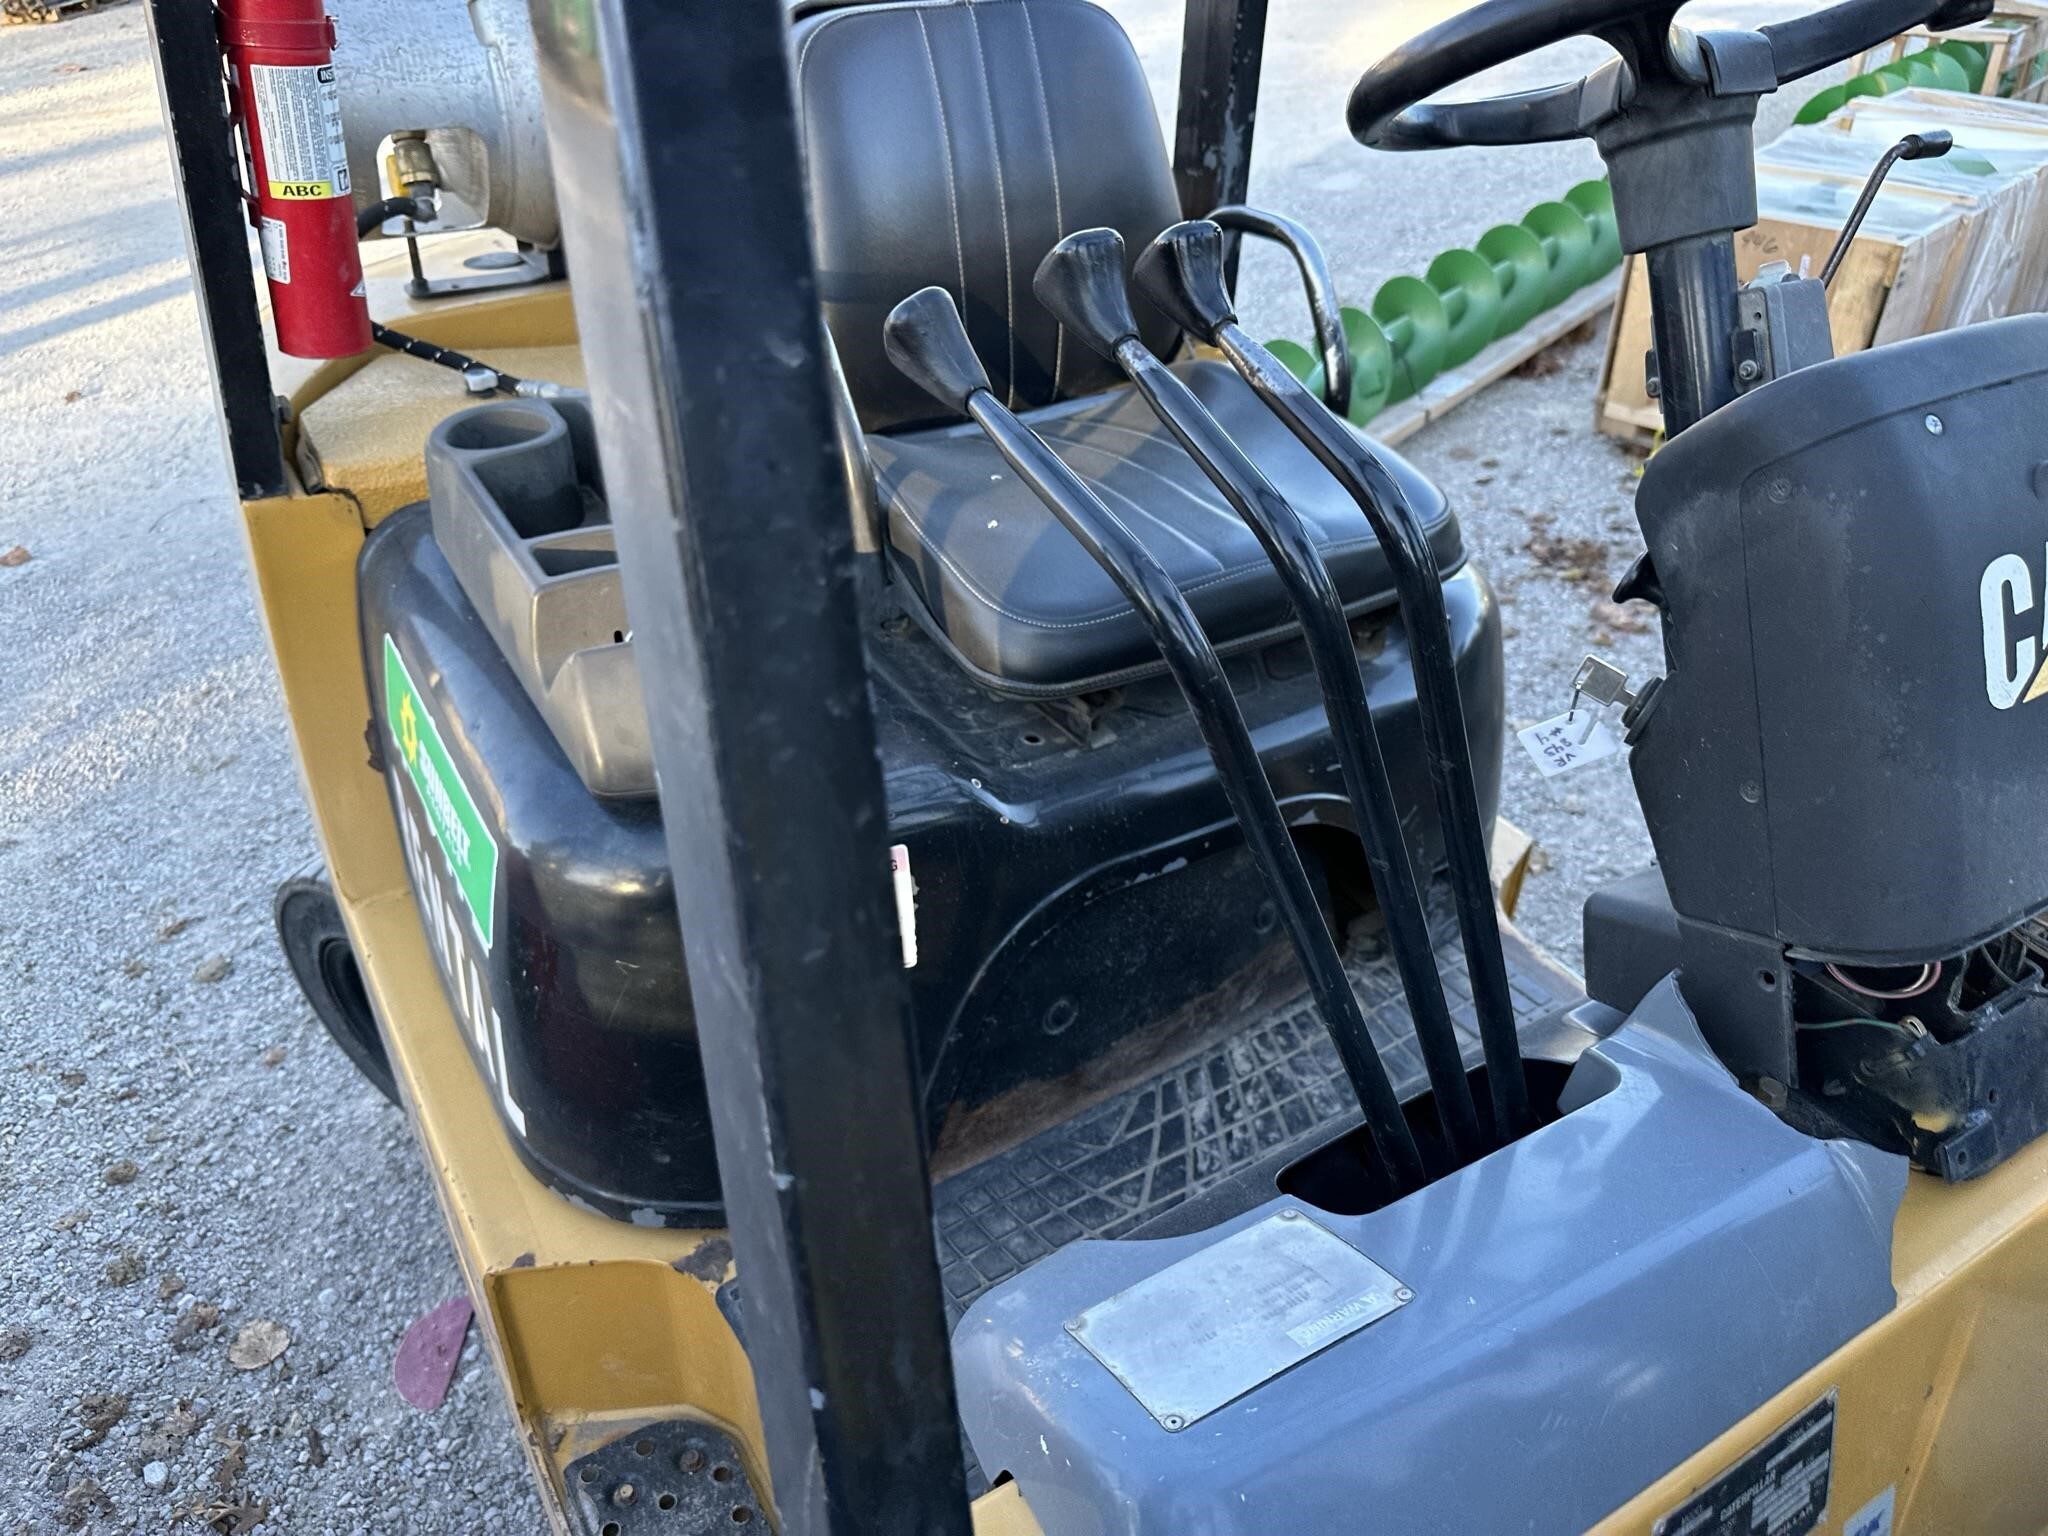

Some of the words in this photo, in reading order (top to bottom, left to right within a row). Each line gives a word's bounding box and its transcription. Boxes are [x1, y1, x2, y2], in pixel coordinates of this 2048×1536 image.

[283, 185, 322, 196] ABC
[1302, 1301, 1362, 1338] WARNING
[1720, 1467, 1776, 1522] CATERPILLAR
